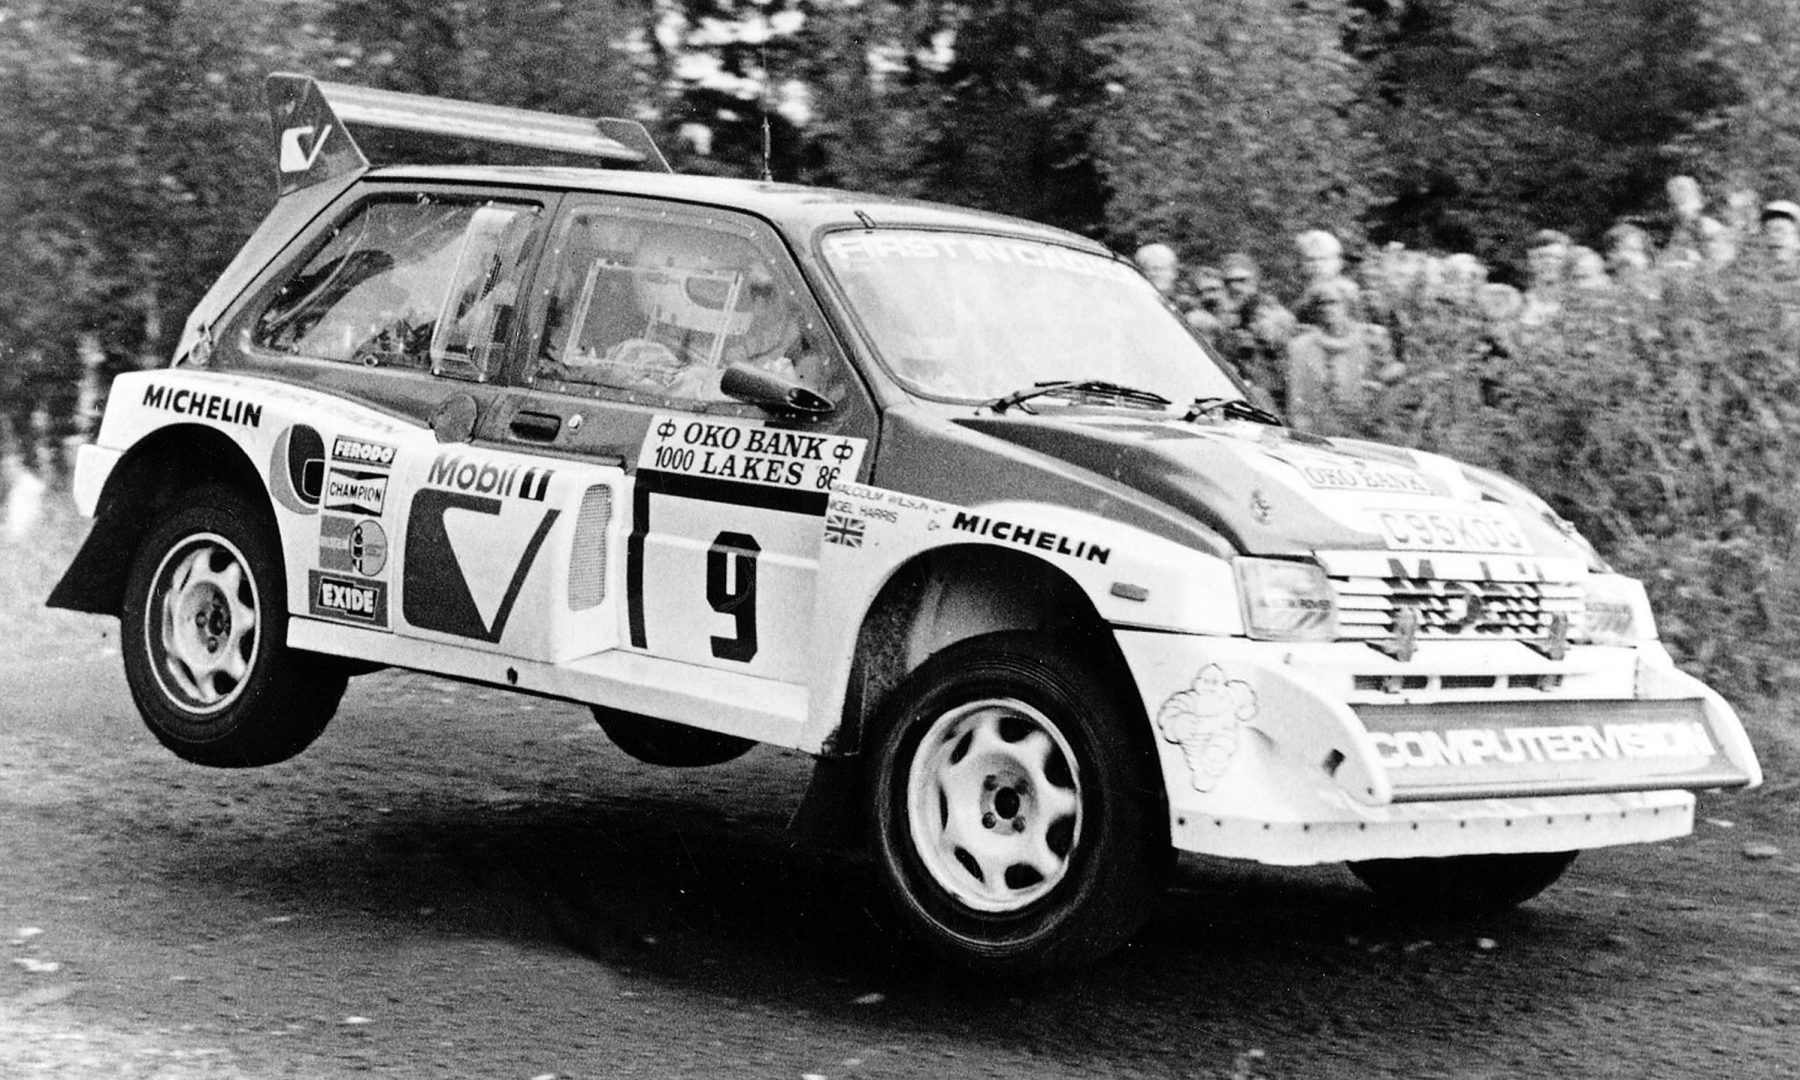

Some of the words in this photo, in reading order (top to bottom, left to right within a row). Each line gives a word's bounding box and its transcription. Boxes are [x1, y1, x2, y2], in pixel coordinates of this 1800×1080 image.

[142, 384, 263, 428] MICHELIN
[333, 440, 394, 463] FERODO
[684, 422, 741, 449] OKO
[744, 429, 828, 460] BANK
[427, 453, 521, 496] Mobil
[655, 446, 695, 471] 1000
[700, 452, 805, 486] LAKES
[1304, 467, 1358, 486] OKO
[1361, 469, 1428, 492] BANK
[329, 484, 383, 503] CHAMPION
[860, 506, 899, 524] HARRIS
[952, 511, 1112, 565] MICHELIN
[322, 582, 376, 614] EXIDE
[706, 531, 762, 663] 9
[1364, 722, 1717, 769] COMPUTERVISION
